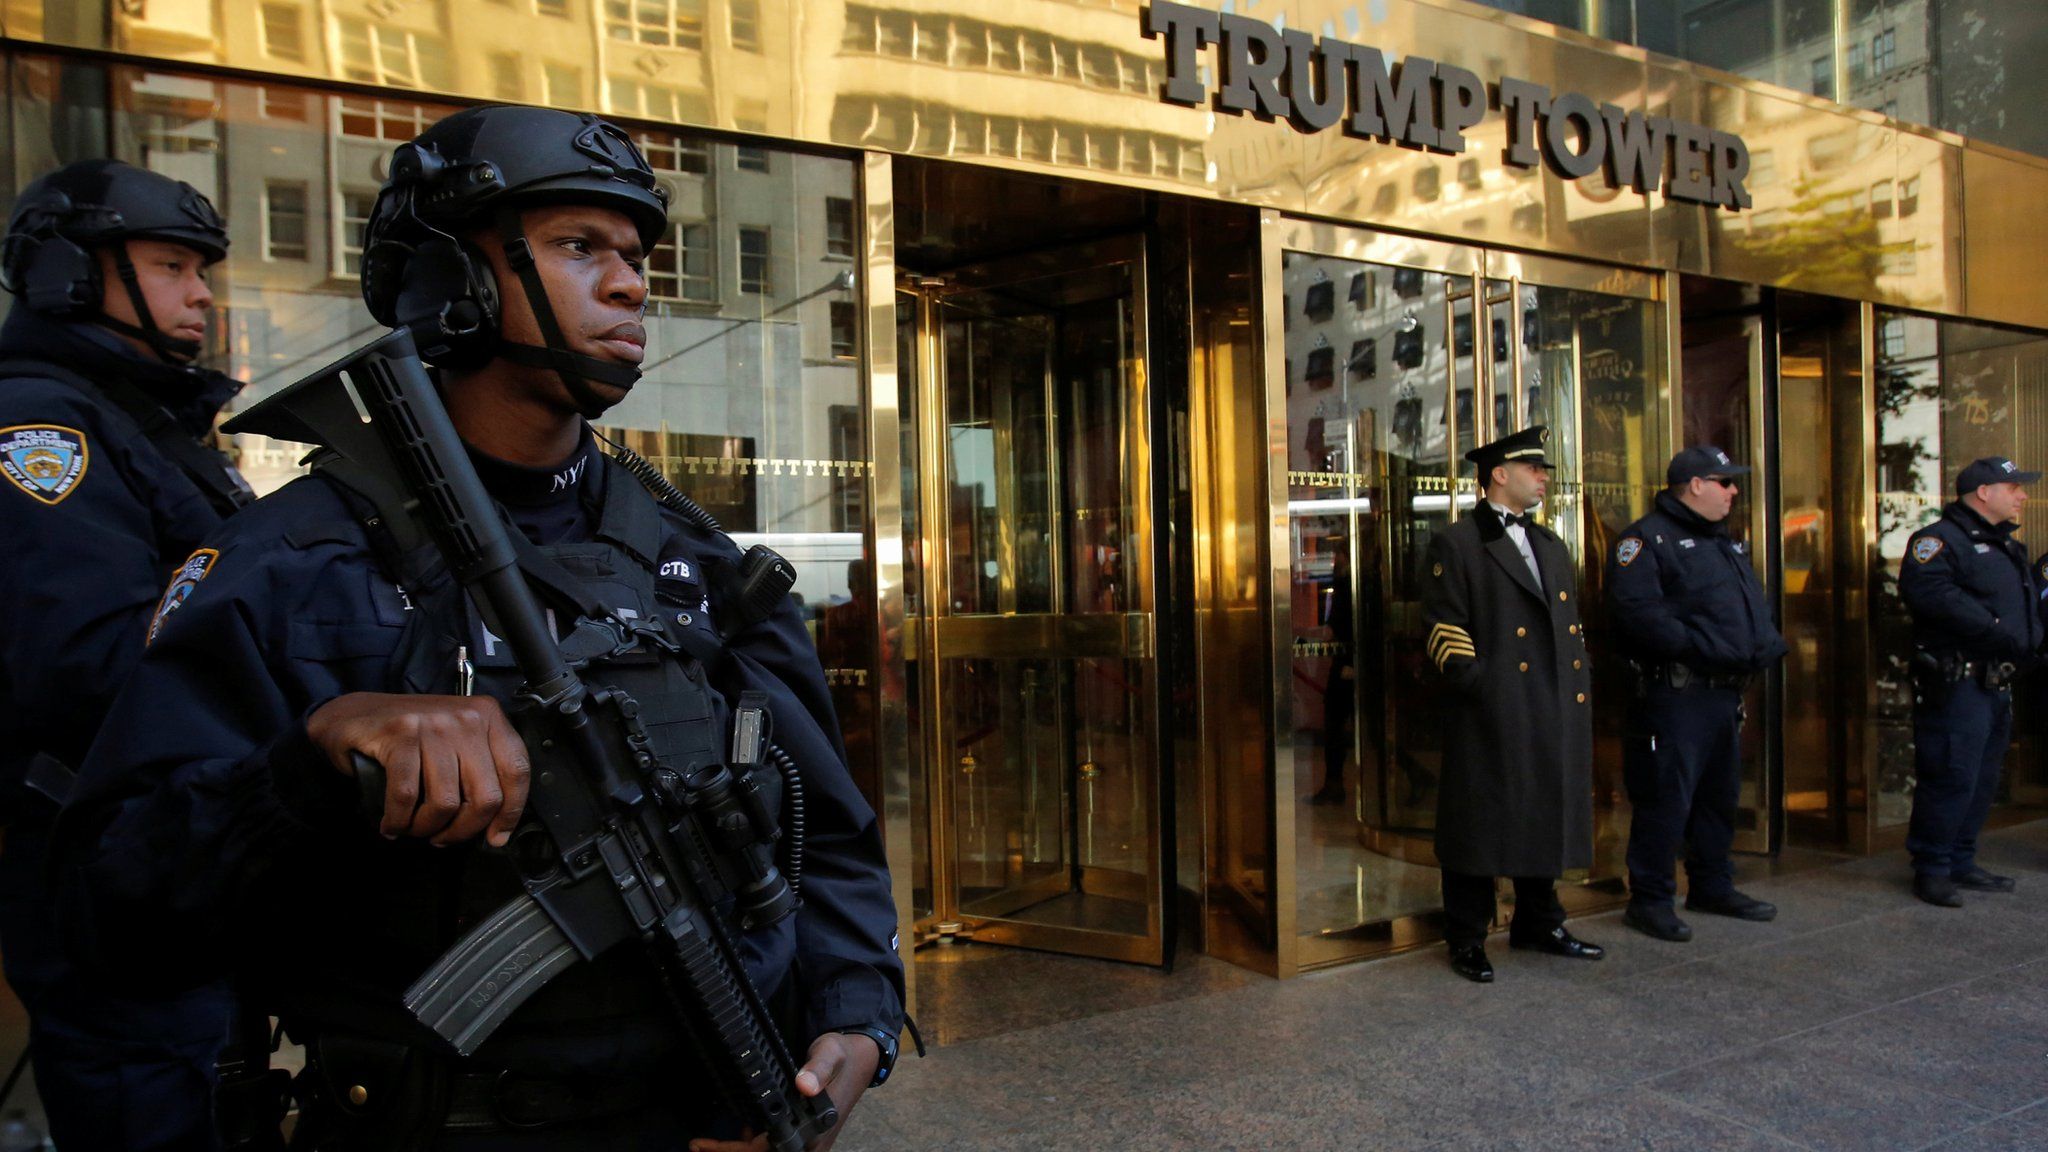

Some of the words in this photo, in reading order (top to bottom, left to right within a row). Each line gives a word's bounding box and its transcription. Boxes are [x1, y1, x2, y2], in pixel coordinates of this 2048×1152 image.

[1142, 0, 1487, 153] TRUMP
[1492, 76, 1752, 211] TOWER
[659, 561, 691, 578] CTB
